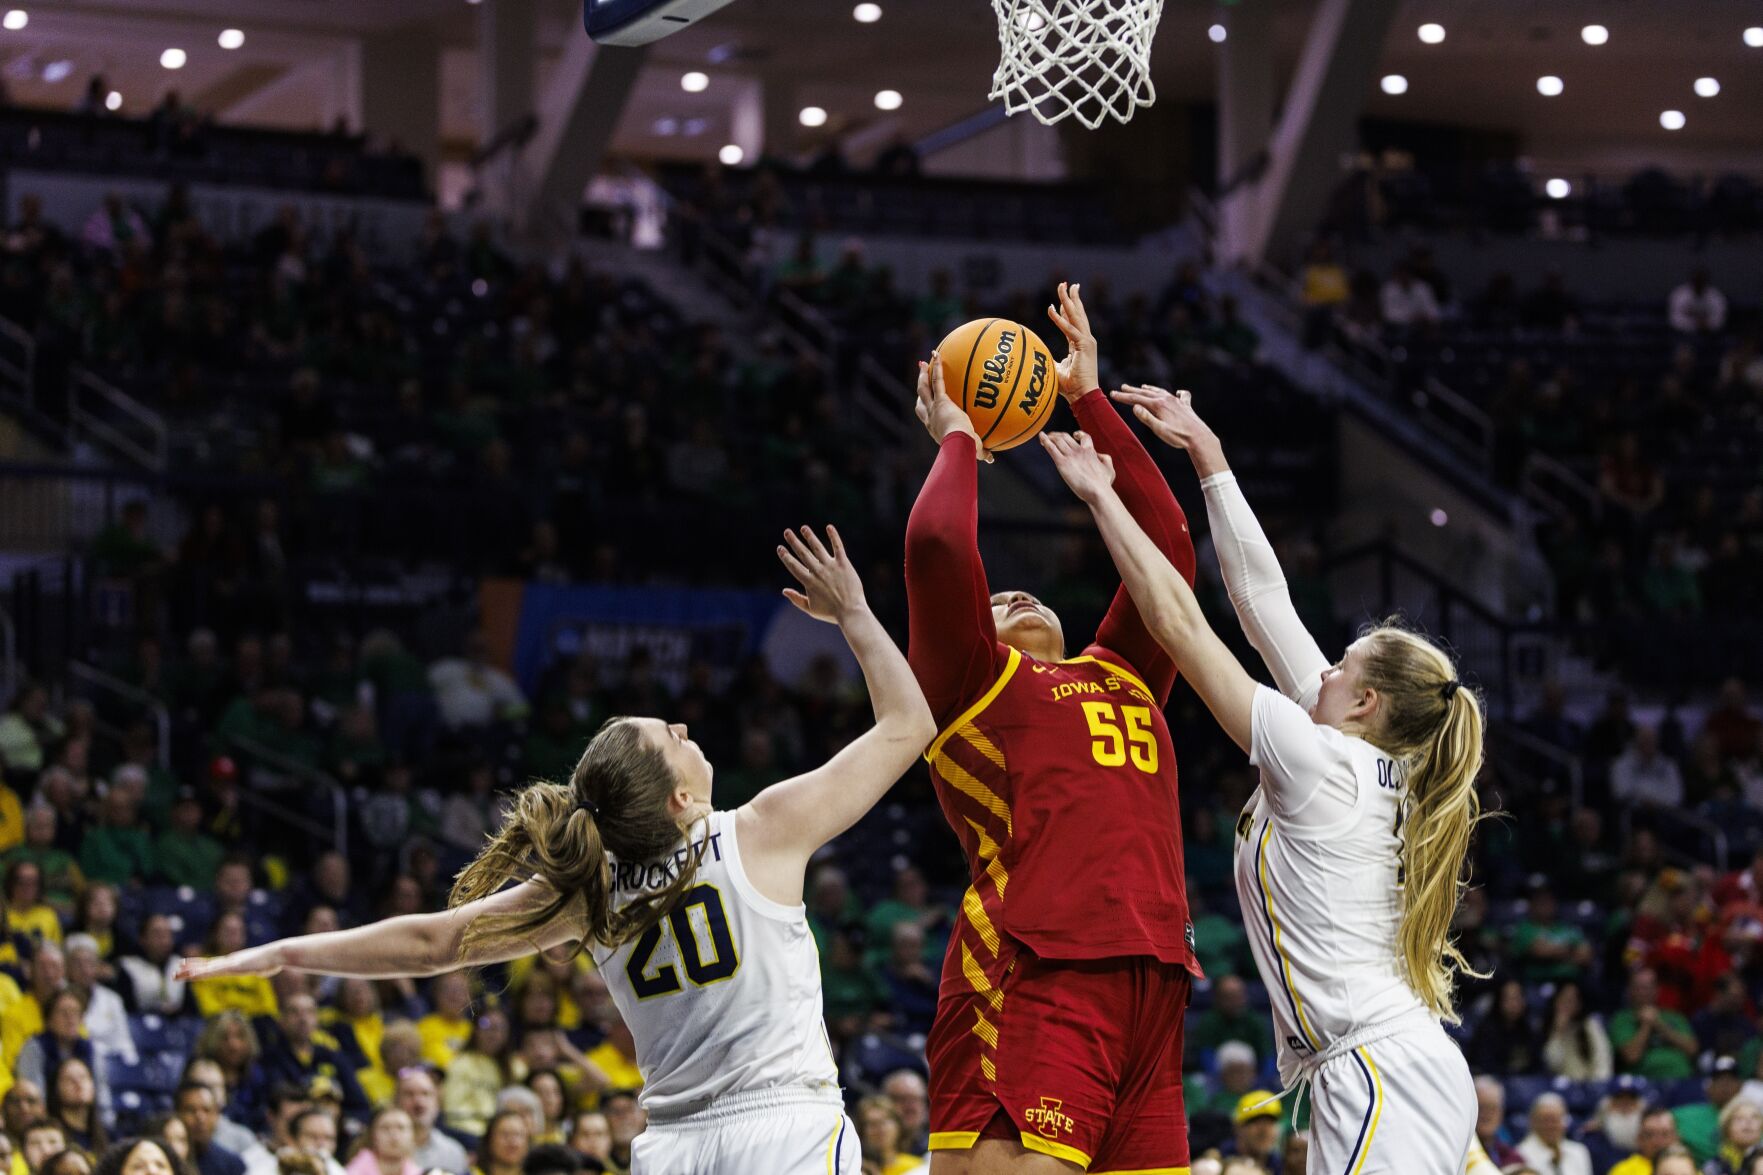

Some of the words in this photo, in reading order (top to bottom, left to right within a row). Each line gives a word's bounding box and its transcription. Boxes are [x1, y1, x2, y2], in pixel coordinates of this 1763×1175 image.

[974, 330, 1017, 409] Wilson
[1019, 350, 1047, 416] NCAA
[1051, 681, 1104, 702] IOWA
[1081, 701, 1159, 774] 55
[625, 881, 741, 1001] 20
[1025, 1108, 1074, 1134] STATE
